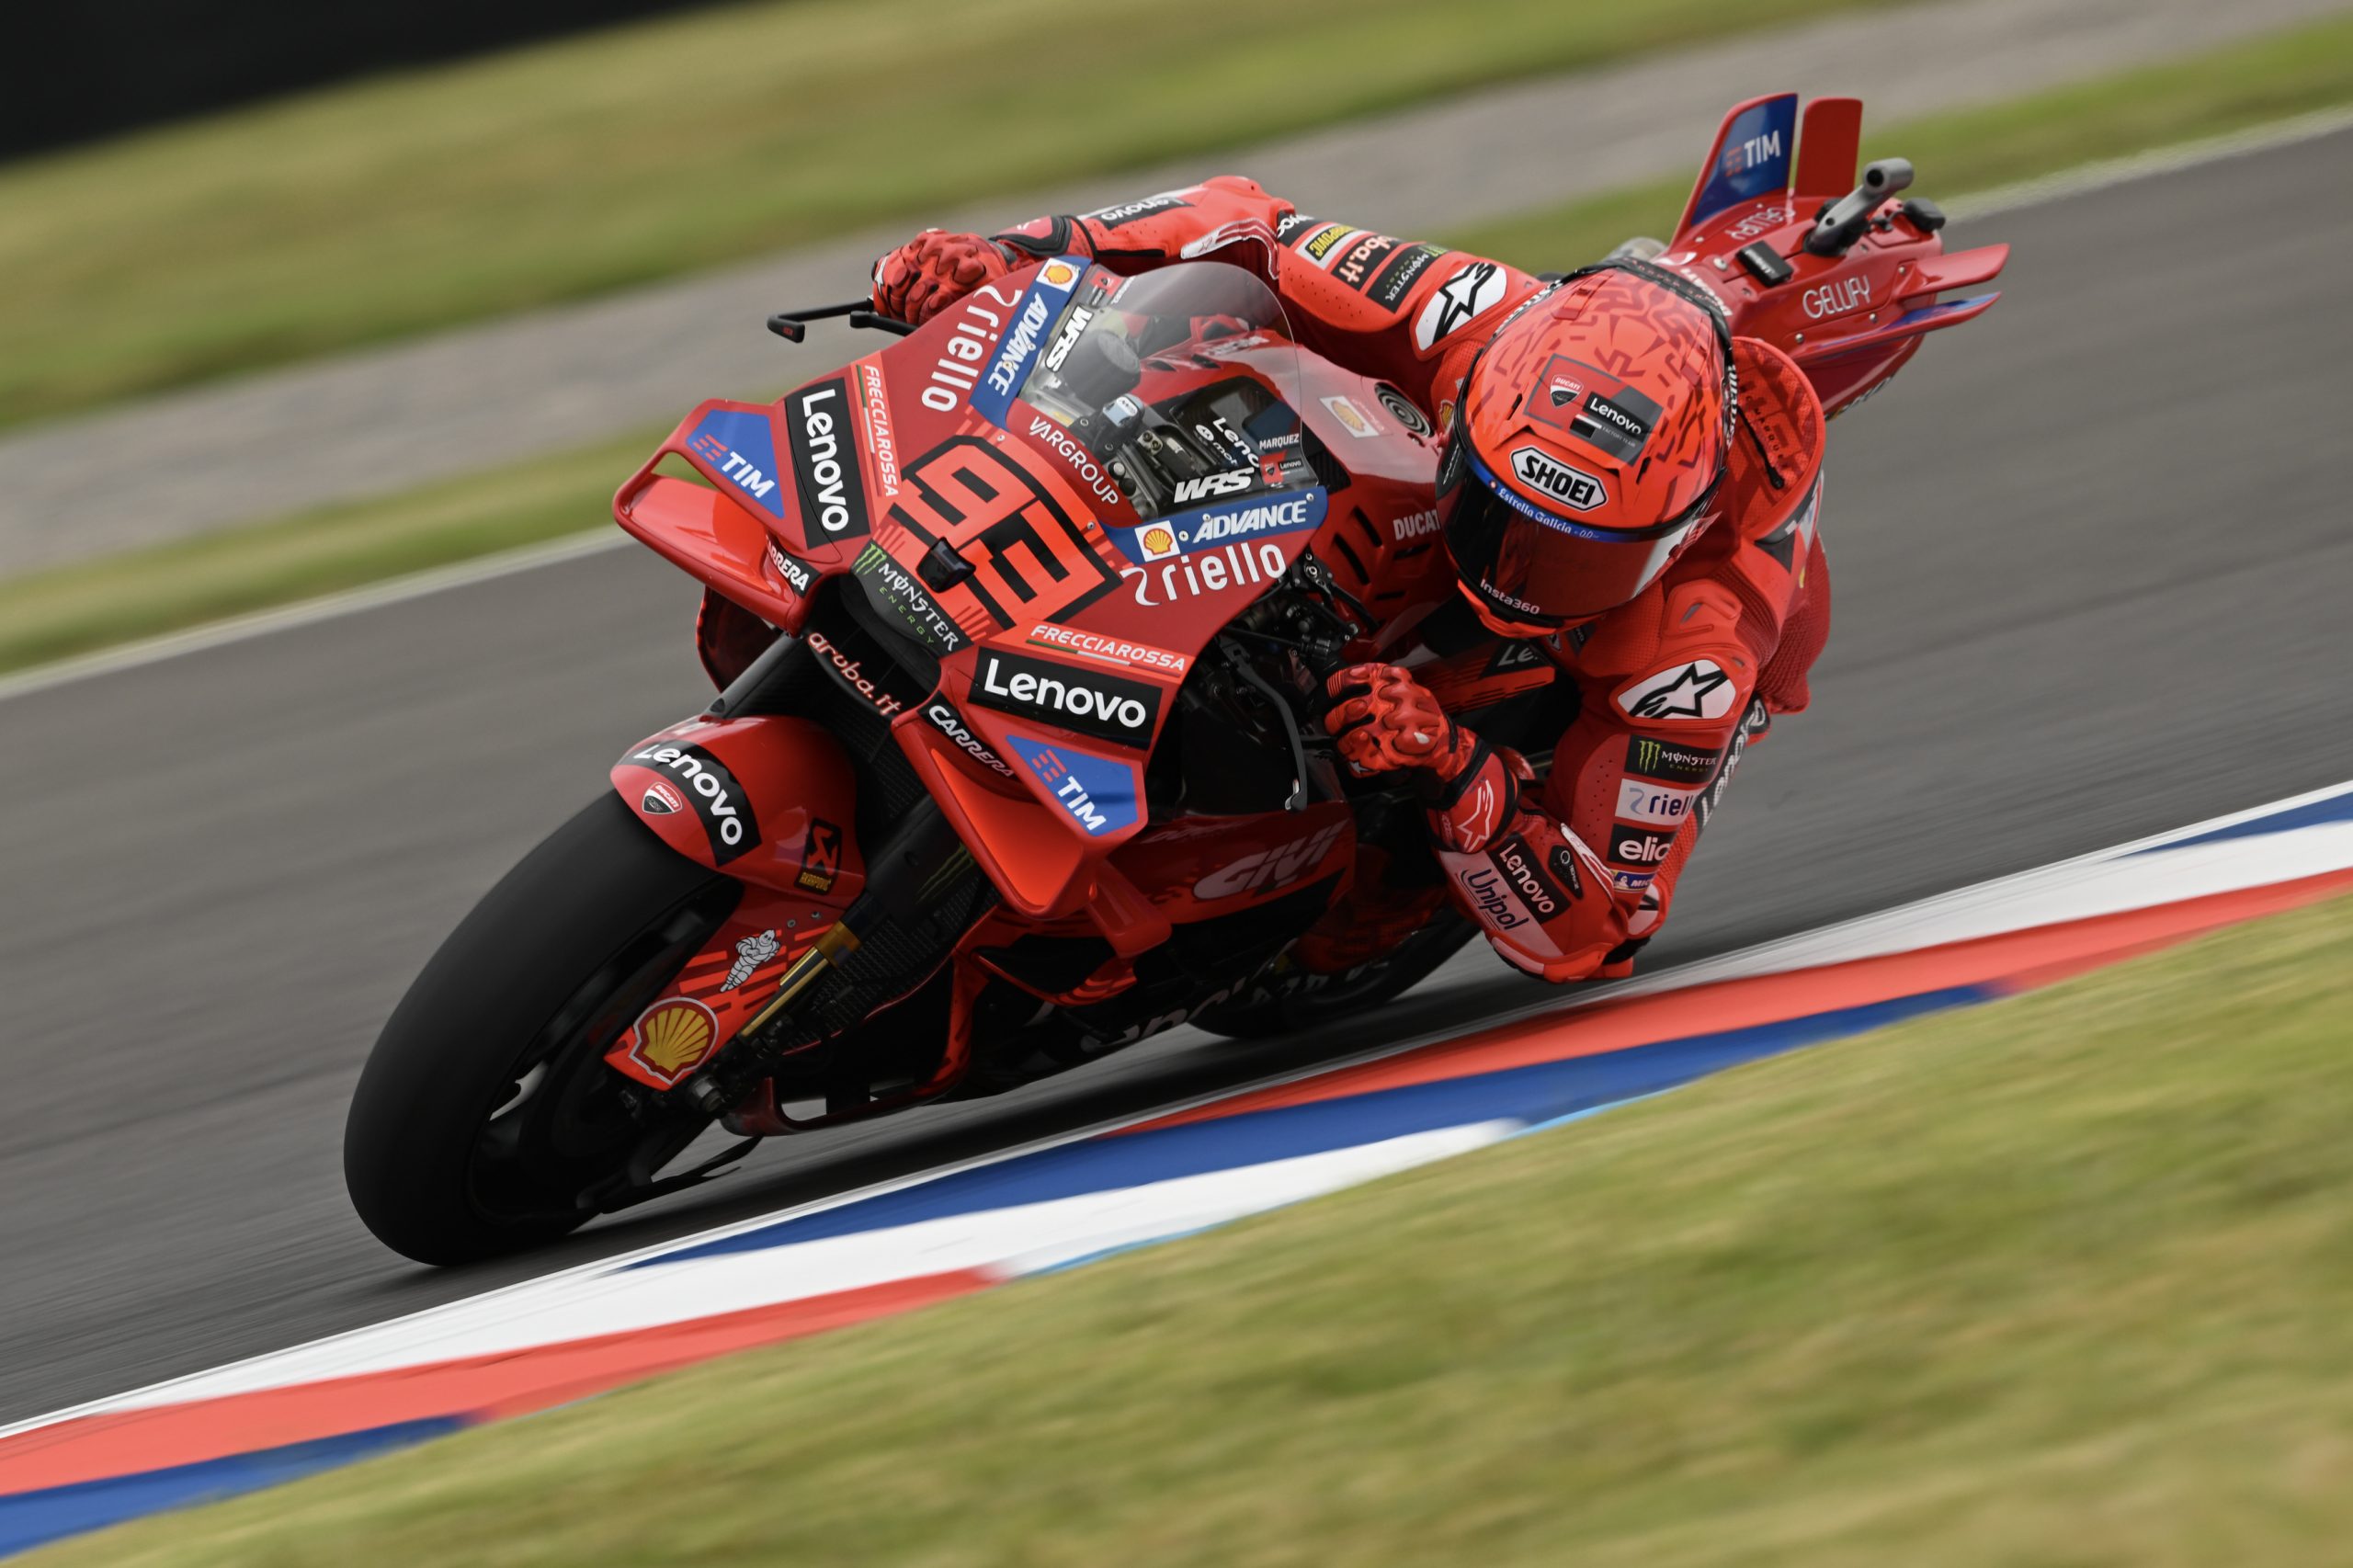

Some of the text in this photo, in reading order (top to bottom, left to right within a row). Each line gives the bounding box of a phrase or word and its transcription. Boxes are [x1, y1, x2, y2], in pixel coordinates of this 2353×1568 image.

[1744, 130, 1781, 168] TIM
[1802, 276, 1870, 320] GELLIFY
[922, 305, 999, 412] riello
[988, 292, 1048, 396] ADVANCE
[1046, 304, 1094, 372] WRS
[1555, 377, 1581, 391] DUCATI
[864, 365, 899, 497] FRECCIAROSSA
[1259, 433, 1300, 450] MARQUEZ
[1590, 397, 1642, 435] Lenovo
[1602, 426, 1636, 448] FACTORY TEAM
[722, 451, 775, 498] TIM
[802, 389, 848, 532] Lenovo
[1029, 415, 1120, 506] VARGROUP
[1174, 467, 1255, 504] WRS
[1279, 460, 1302, 471] Lenovo
[1521, 455, 1596, 506] SHOEI
[882, 435, 1123, 631] 93
[1193, 499, 1307, 543] ADVANCE
[1498, 487, 1533, 518] Estrella
[1535, 511, 1572, 534] Galicia
[1161, 542, 1287, 601] riello
[1480, 579, 1540, 615] Insta360
[879, 562, 960, 652] MONSTER
[879, 586, 934, 643] ENERGY
[809, 631, 905, 717] aruba.it
[1031, 625, 1185, 672] FRECCIAROSSA
[983, 658, 1146, 728] Lenovo
[928, 705, 1015, 777] CARRERA
[1662, 750, 1717, 766] MONSTER
[633, 744, 743, 846] Lenovo
[655, 784, 679, 808] DUCATI
[1057, 775, 1107, 832] TIM
[1467, 869, 1529, 931] Unipol
[1499, 843, 1555, 914] Lenovo
